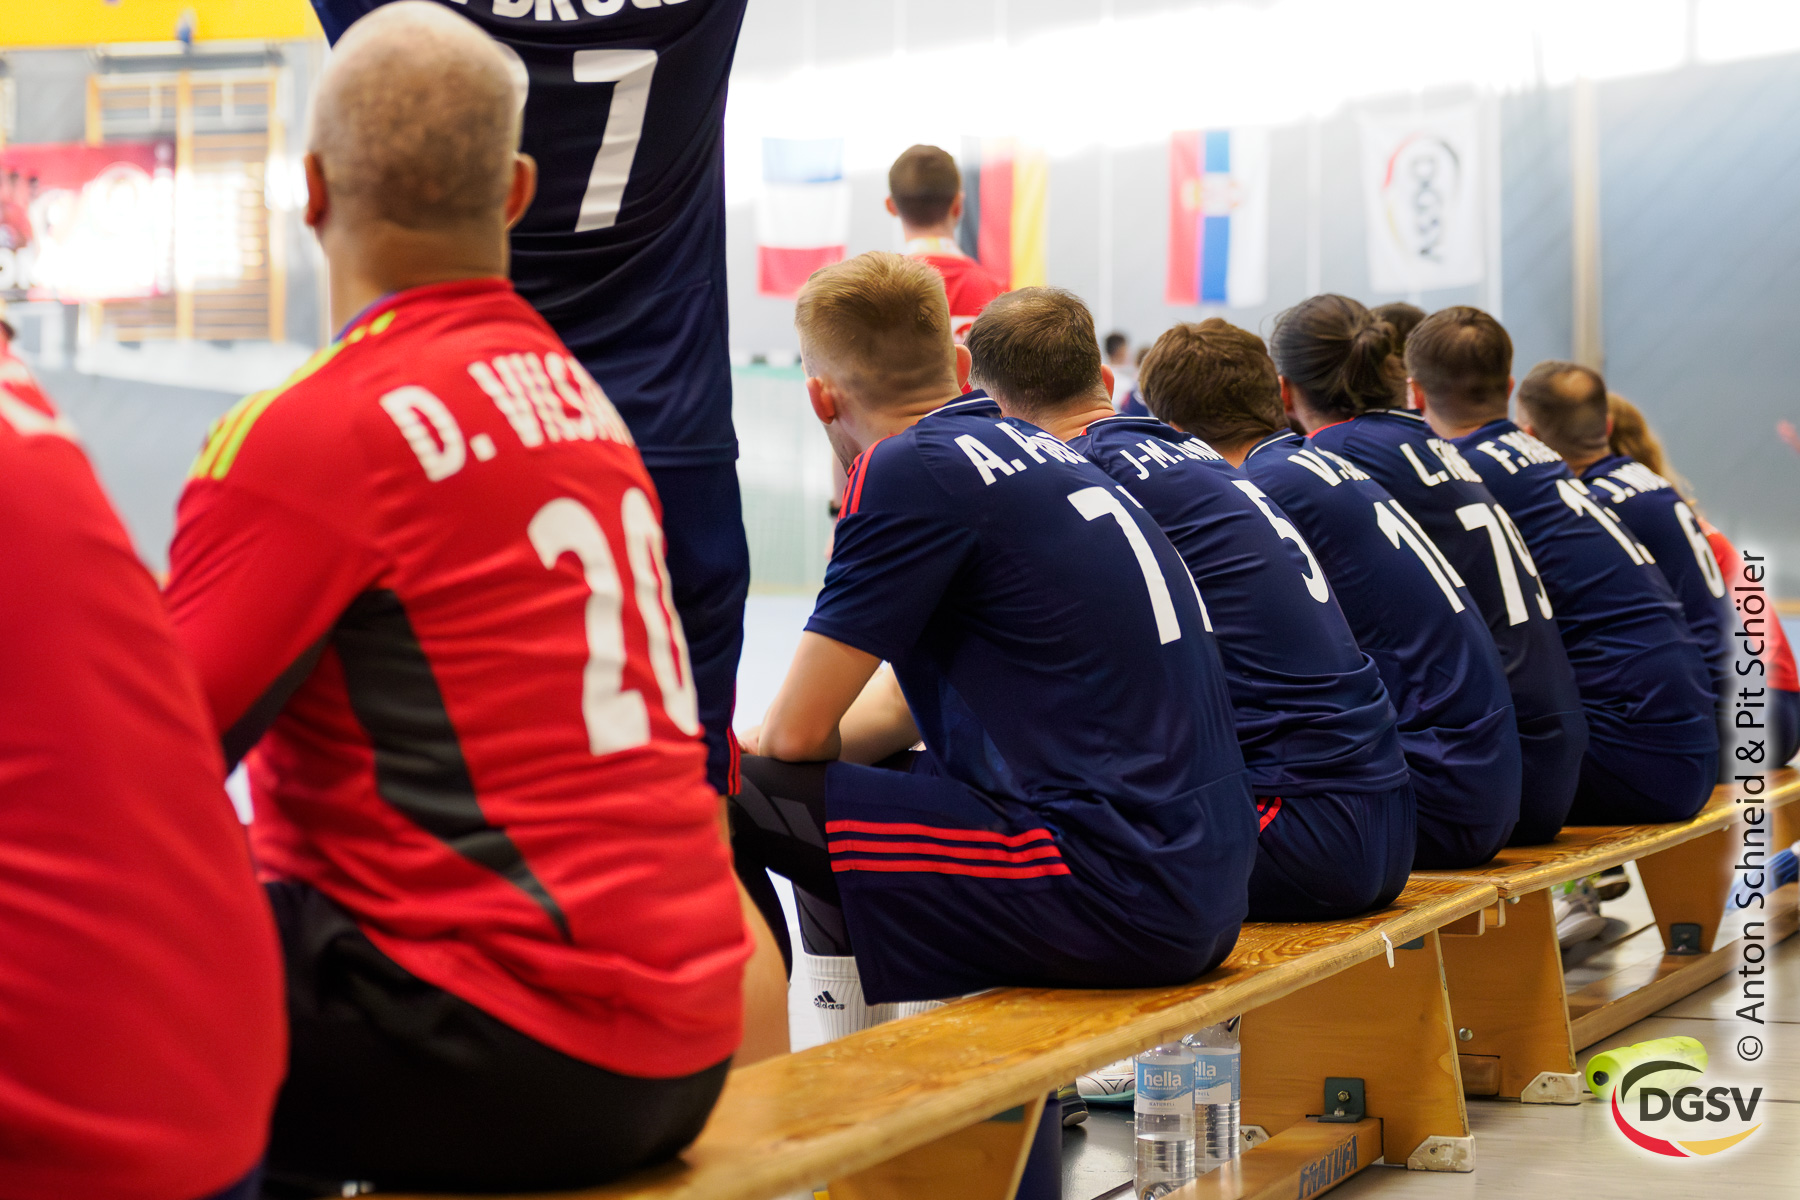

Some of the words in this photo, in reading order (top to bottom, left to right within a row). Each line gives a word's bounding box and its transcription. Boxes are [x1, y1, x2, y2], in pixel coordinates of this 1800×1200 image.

[1410, 155, 1444, 264] DGSV
[379, 385, 496, 482] D.
[954, 434, 1027, 486] A.
[1067, 486, 1213, 645] 7
[1231, 480, 1329, 604] 5
[527, 487, 699, 756] 20
[1143, 1068, 1182, 1087] hella
